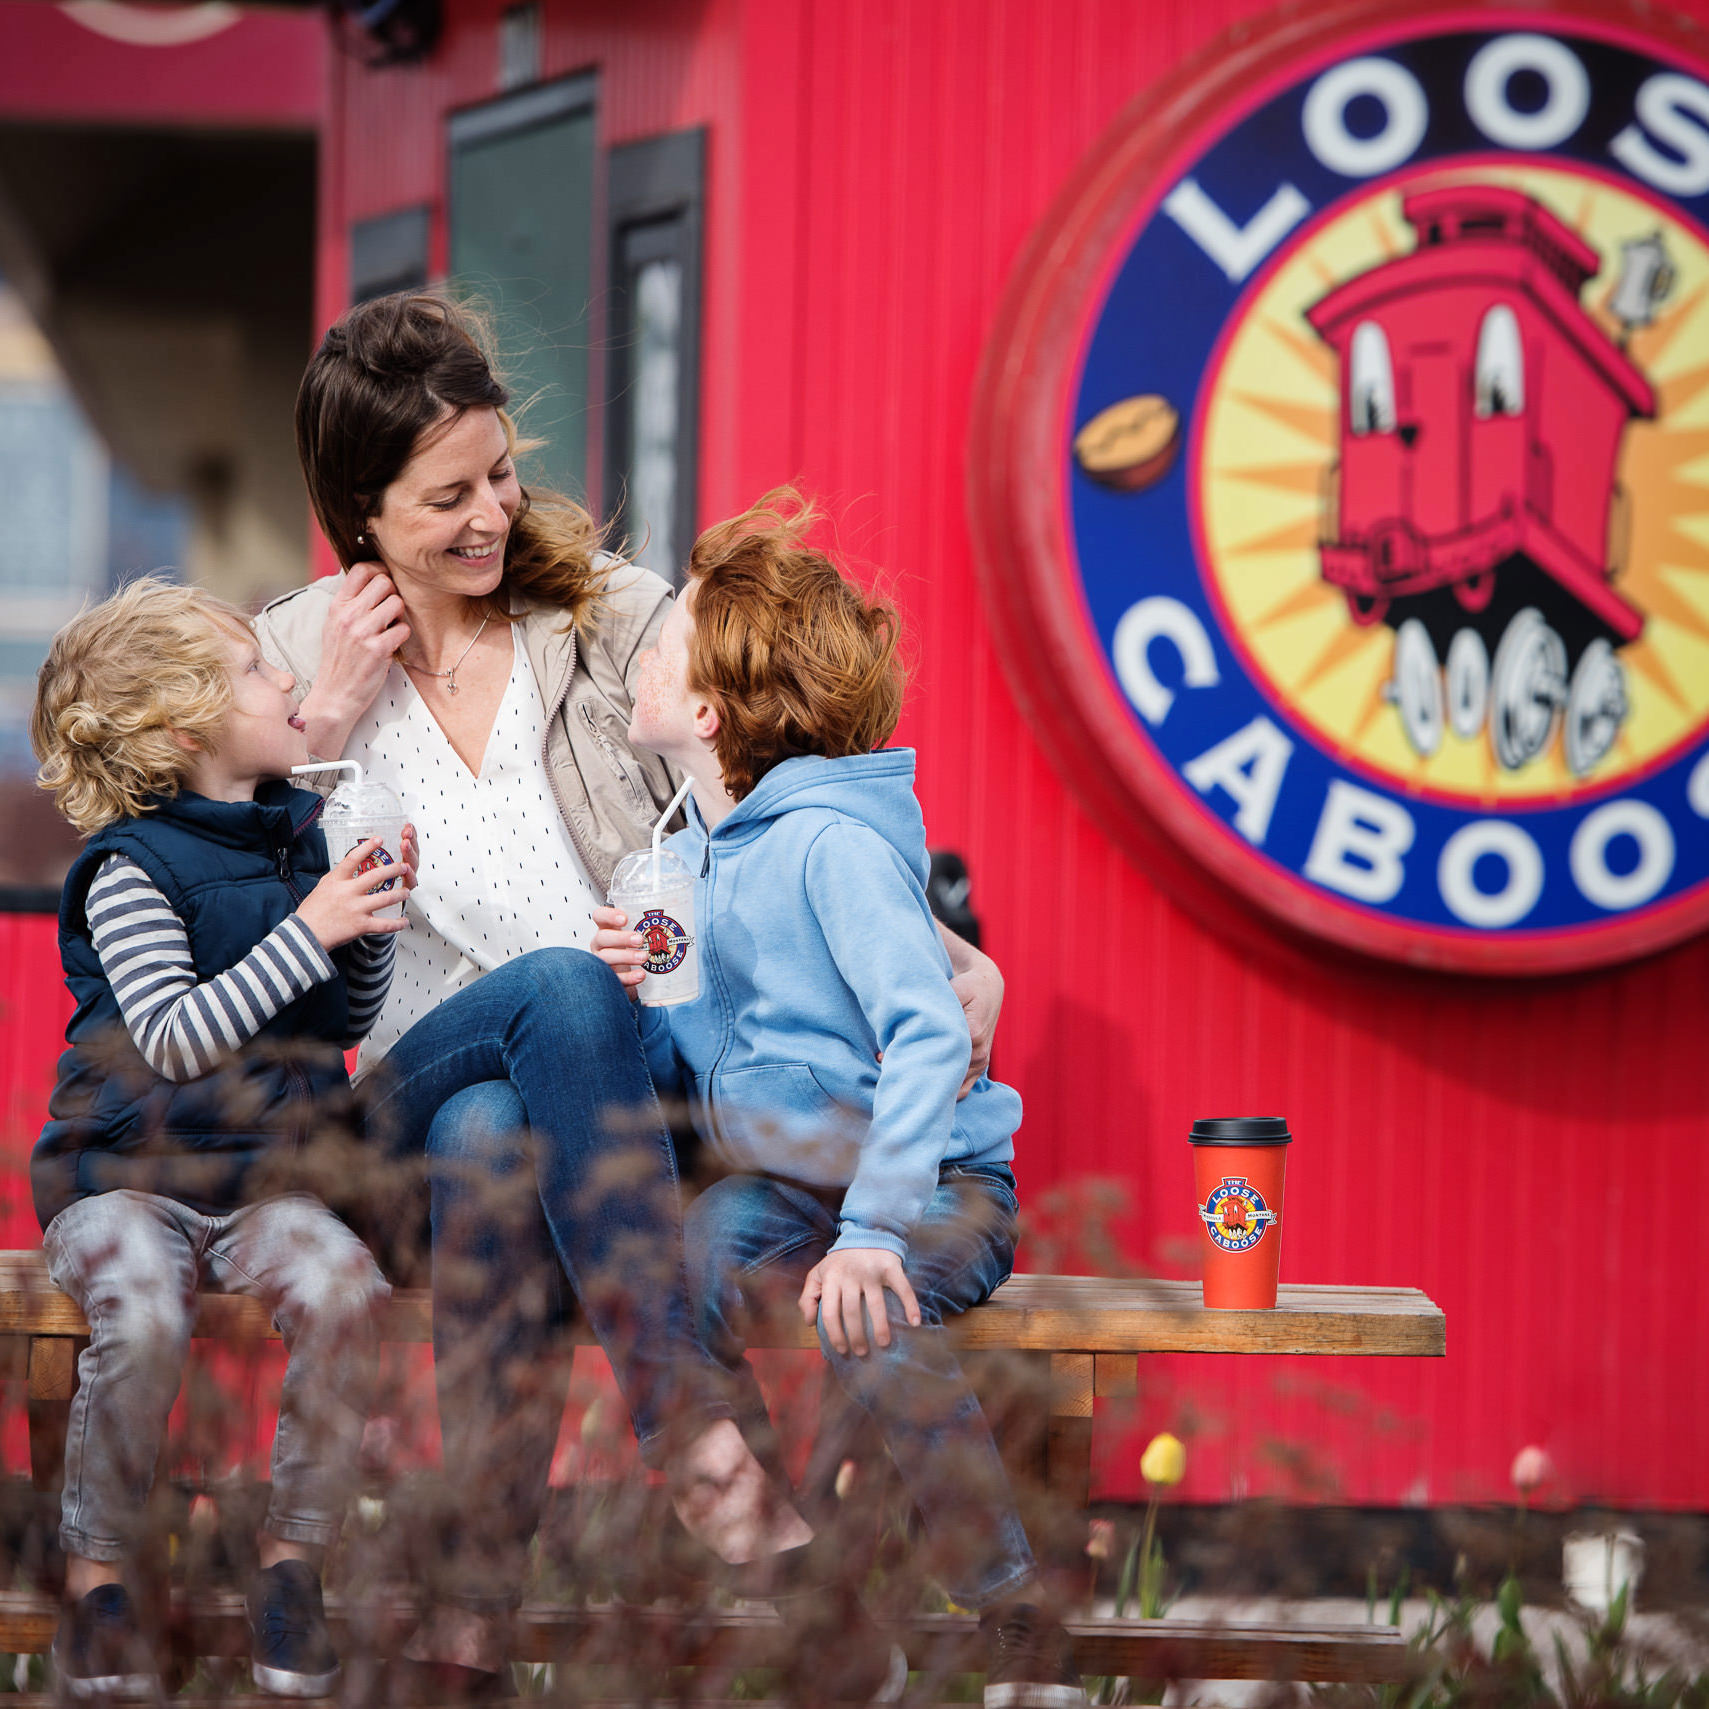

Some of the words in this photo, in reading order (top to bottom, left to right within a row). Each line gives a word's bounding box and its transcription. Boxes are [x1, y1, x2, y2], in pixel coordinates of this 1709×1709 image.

[1113, 596, 1709, 928] CABOO
[643, 950, 684, 971] ABOOSE
[1212, 1187, 1260, 1204] LOOSE
[1210, 1226, 1263, 1249] CABOOSE
